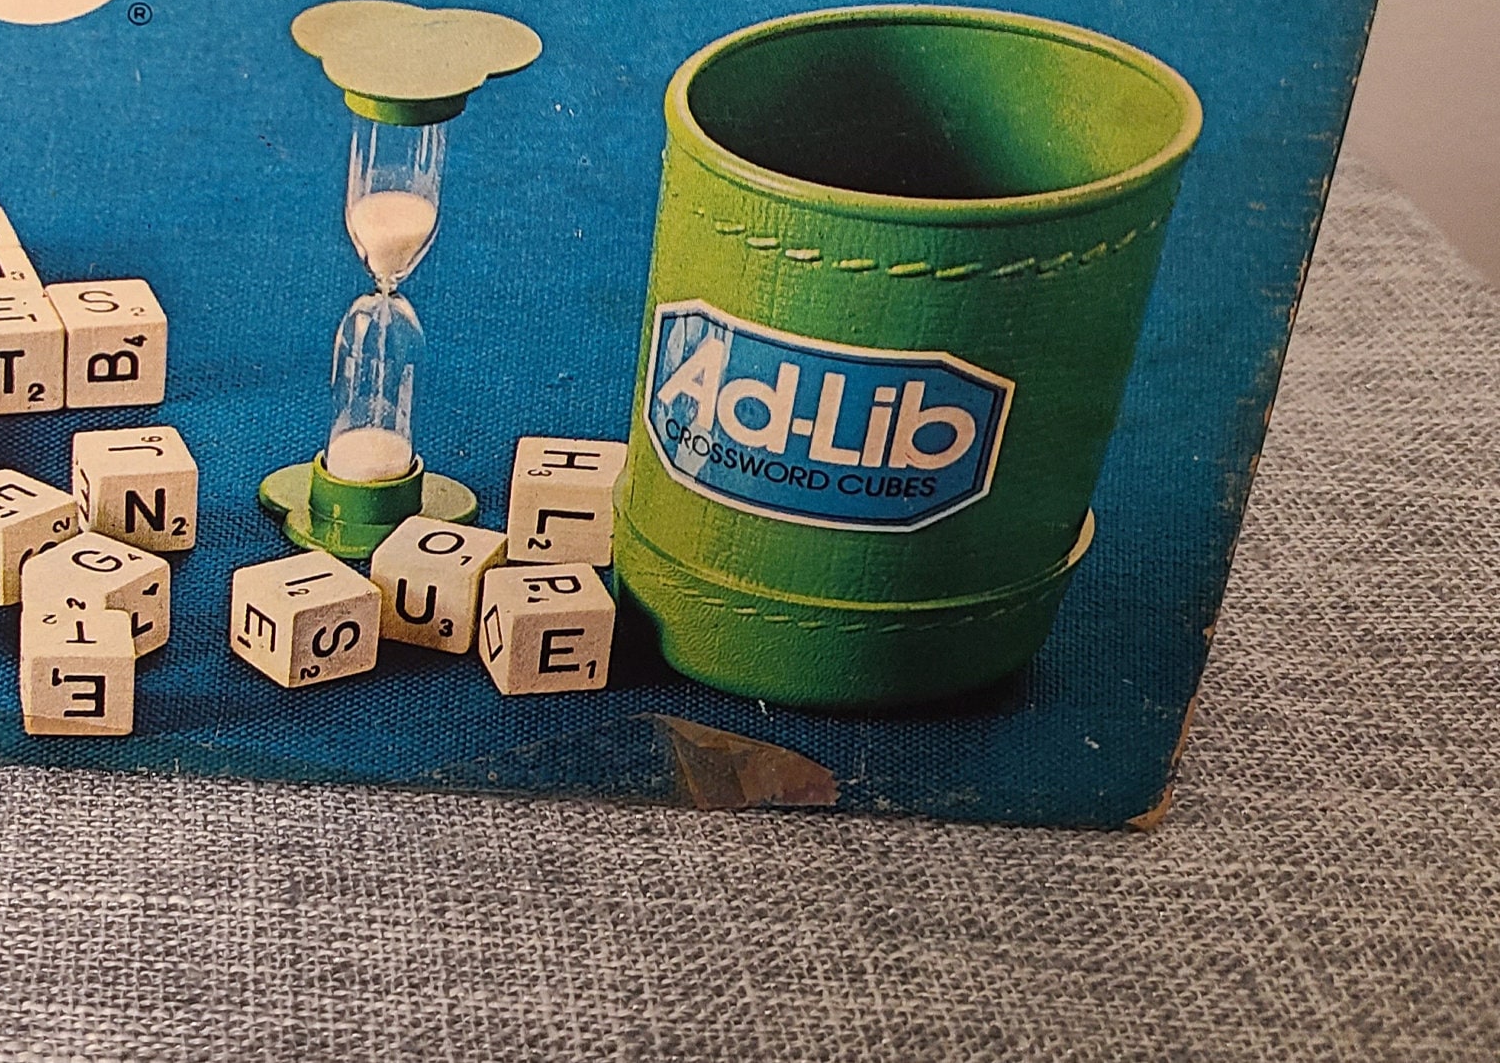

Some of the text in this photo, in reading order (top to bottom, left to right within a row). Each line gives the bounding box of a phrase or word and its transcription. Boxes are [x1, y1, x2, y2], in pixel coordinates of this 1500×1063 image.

[78, 290, 120, 313] S
[86, 350, 140, 383] B
[657, 339, 976, 471] Ad-Lib
[542, 449, 601, 471] H
[665, 418, 937, 499] CROSSWORD CUBES
[124, 487, 167, 534] N
[536, 509, 595, 536] L
[417, 530, 466, 555] O
[71, 550, 123, 573] G
[395, 578, 437, 625] U
[523, 575, 582, 594] P
[65, 620, 98, 644] T
[246, 603, 276, 653] E
[312, 620, 361, 658] S
[539, 628, 585, 675] E
[63, 675, 106, 718] E
